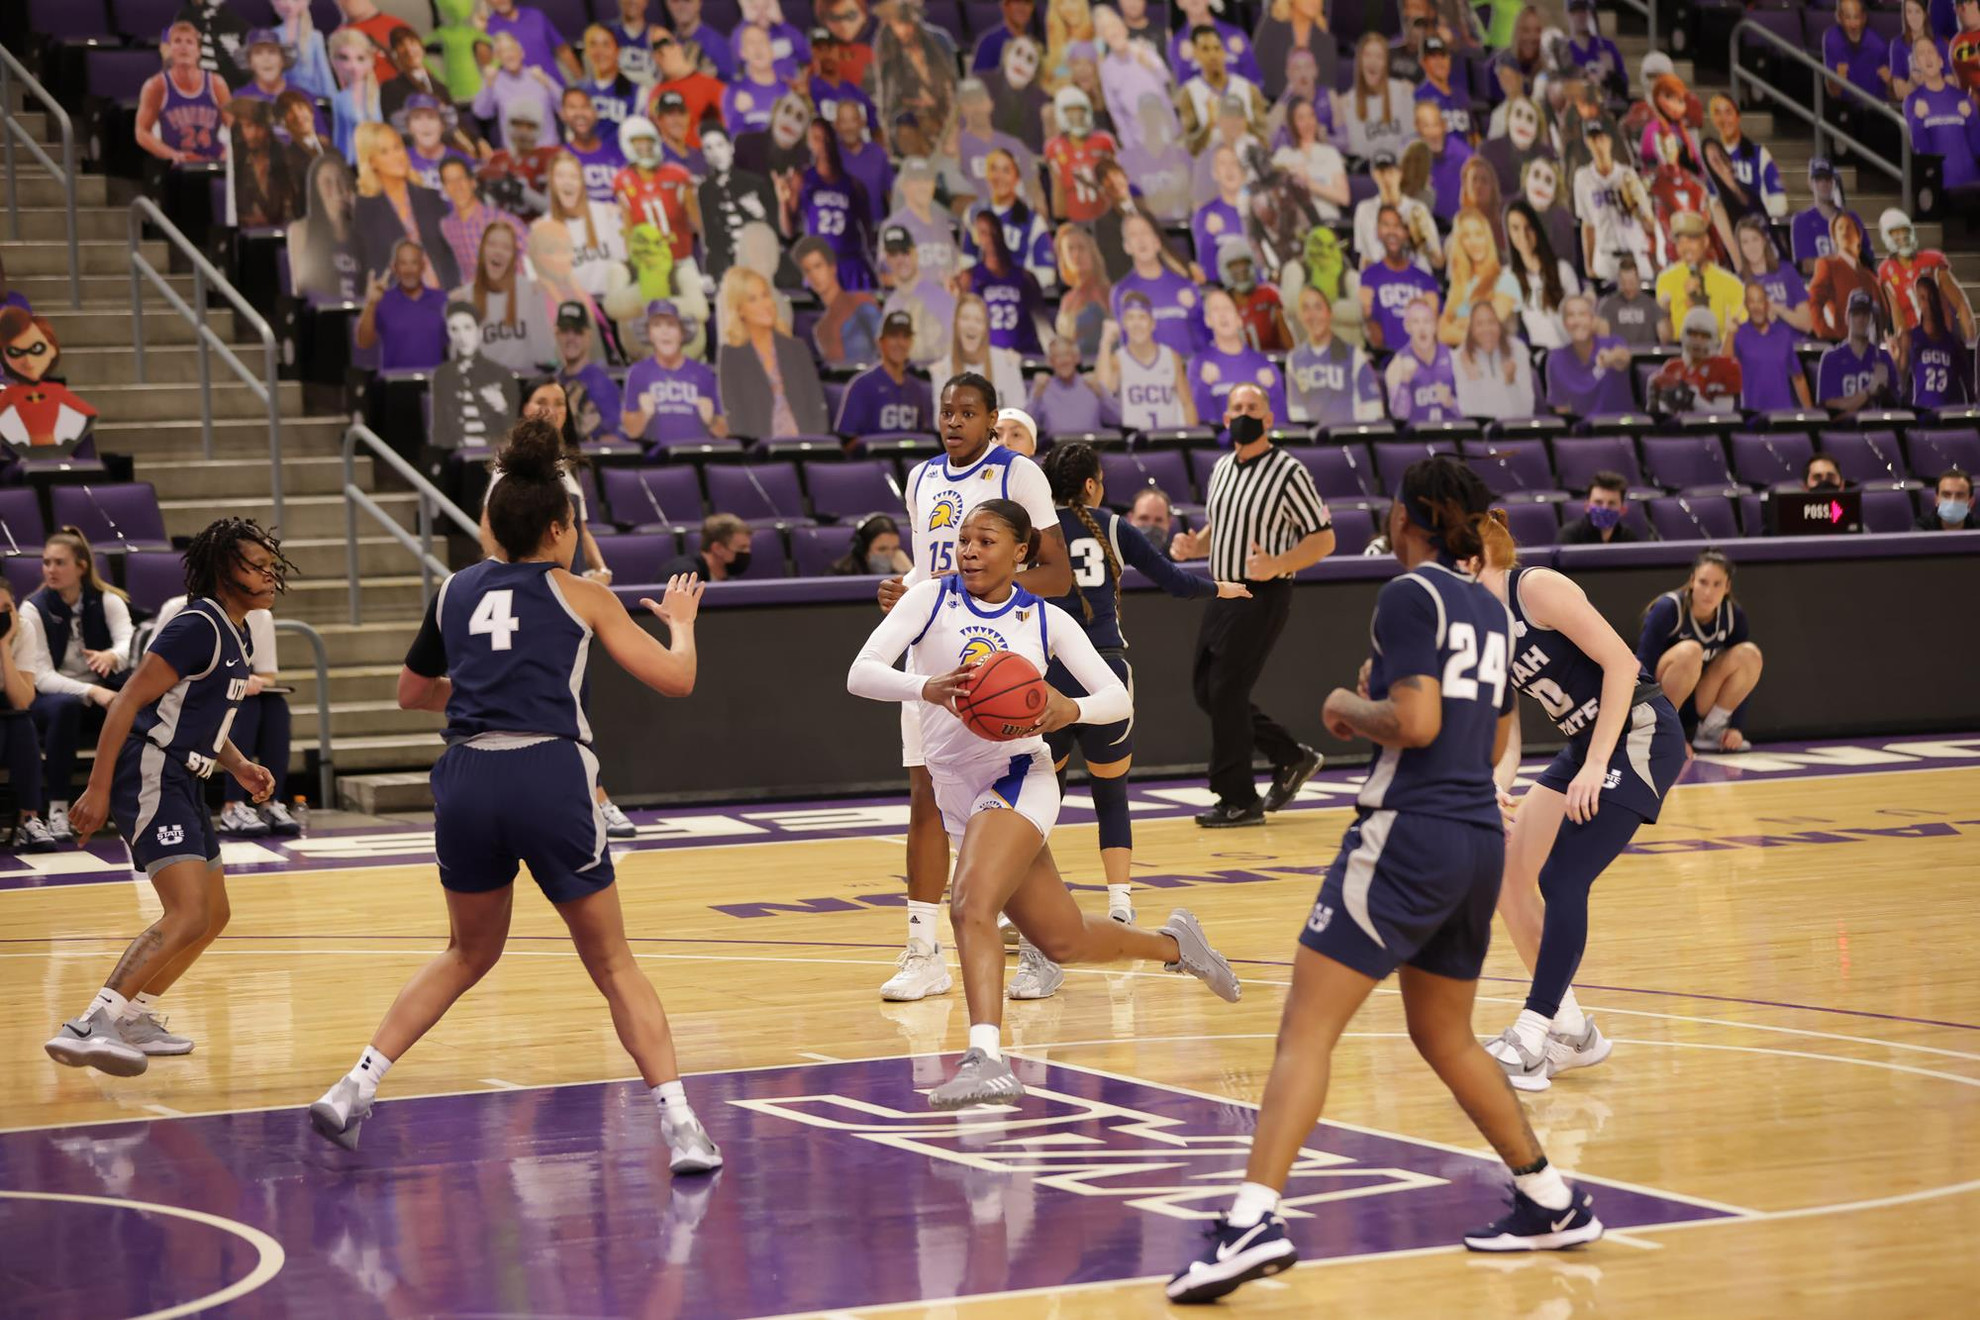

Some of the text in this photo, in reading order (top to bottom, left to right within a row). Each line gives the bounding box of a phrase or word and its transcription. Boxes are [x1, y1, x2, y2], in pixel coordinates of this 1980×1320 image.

[179, 126, 212, 149] 24
[818, 208, 845, 236] 23
[987, 303, 1019, 331] 23
[482, 320, 527, 344] GCU
[648, 380, 700, 405] GCU
[1925, 367, 1948, 393] 23
[929, 541, 955, 573] 15
[1069, 537, 1106, 588] 3
[468, 589, 520, 652] 4
[1442, 620, 1508, 709] 24
[212, 707, 239, 754] 1
